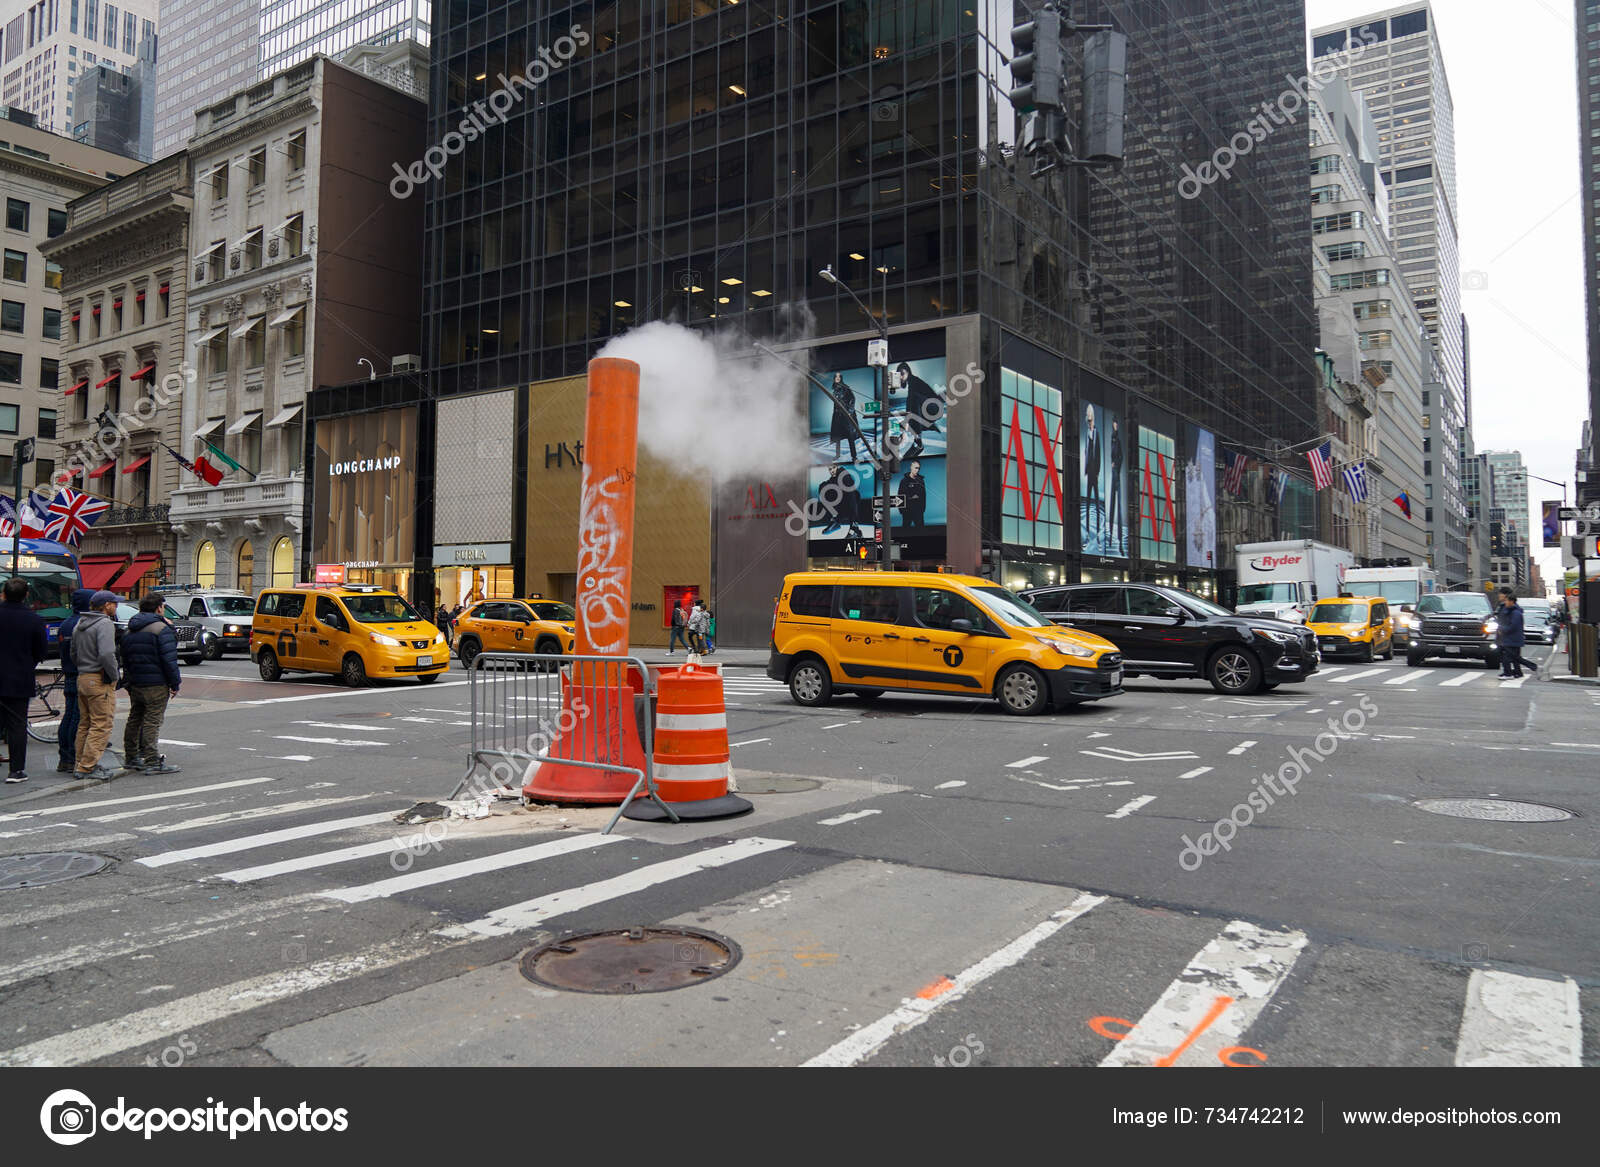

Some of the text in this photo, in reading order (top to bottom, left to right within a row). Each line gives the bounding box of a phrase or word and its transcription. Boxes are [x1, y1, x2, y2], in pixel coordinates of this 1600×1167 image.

[329, 456, 401, 476] LONGCHAMP
[455, 549, 487, 561] FURLA
[1262, 555, 1302, 568] Ryder
